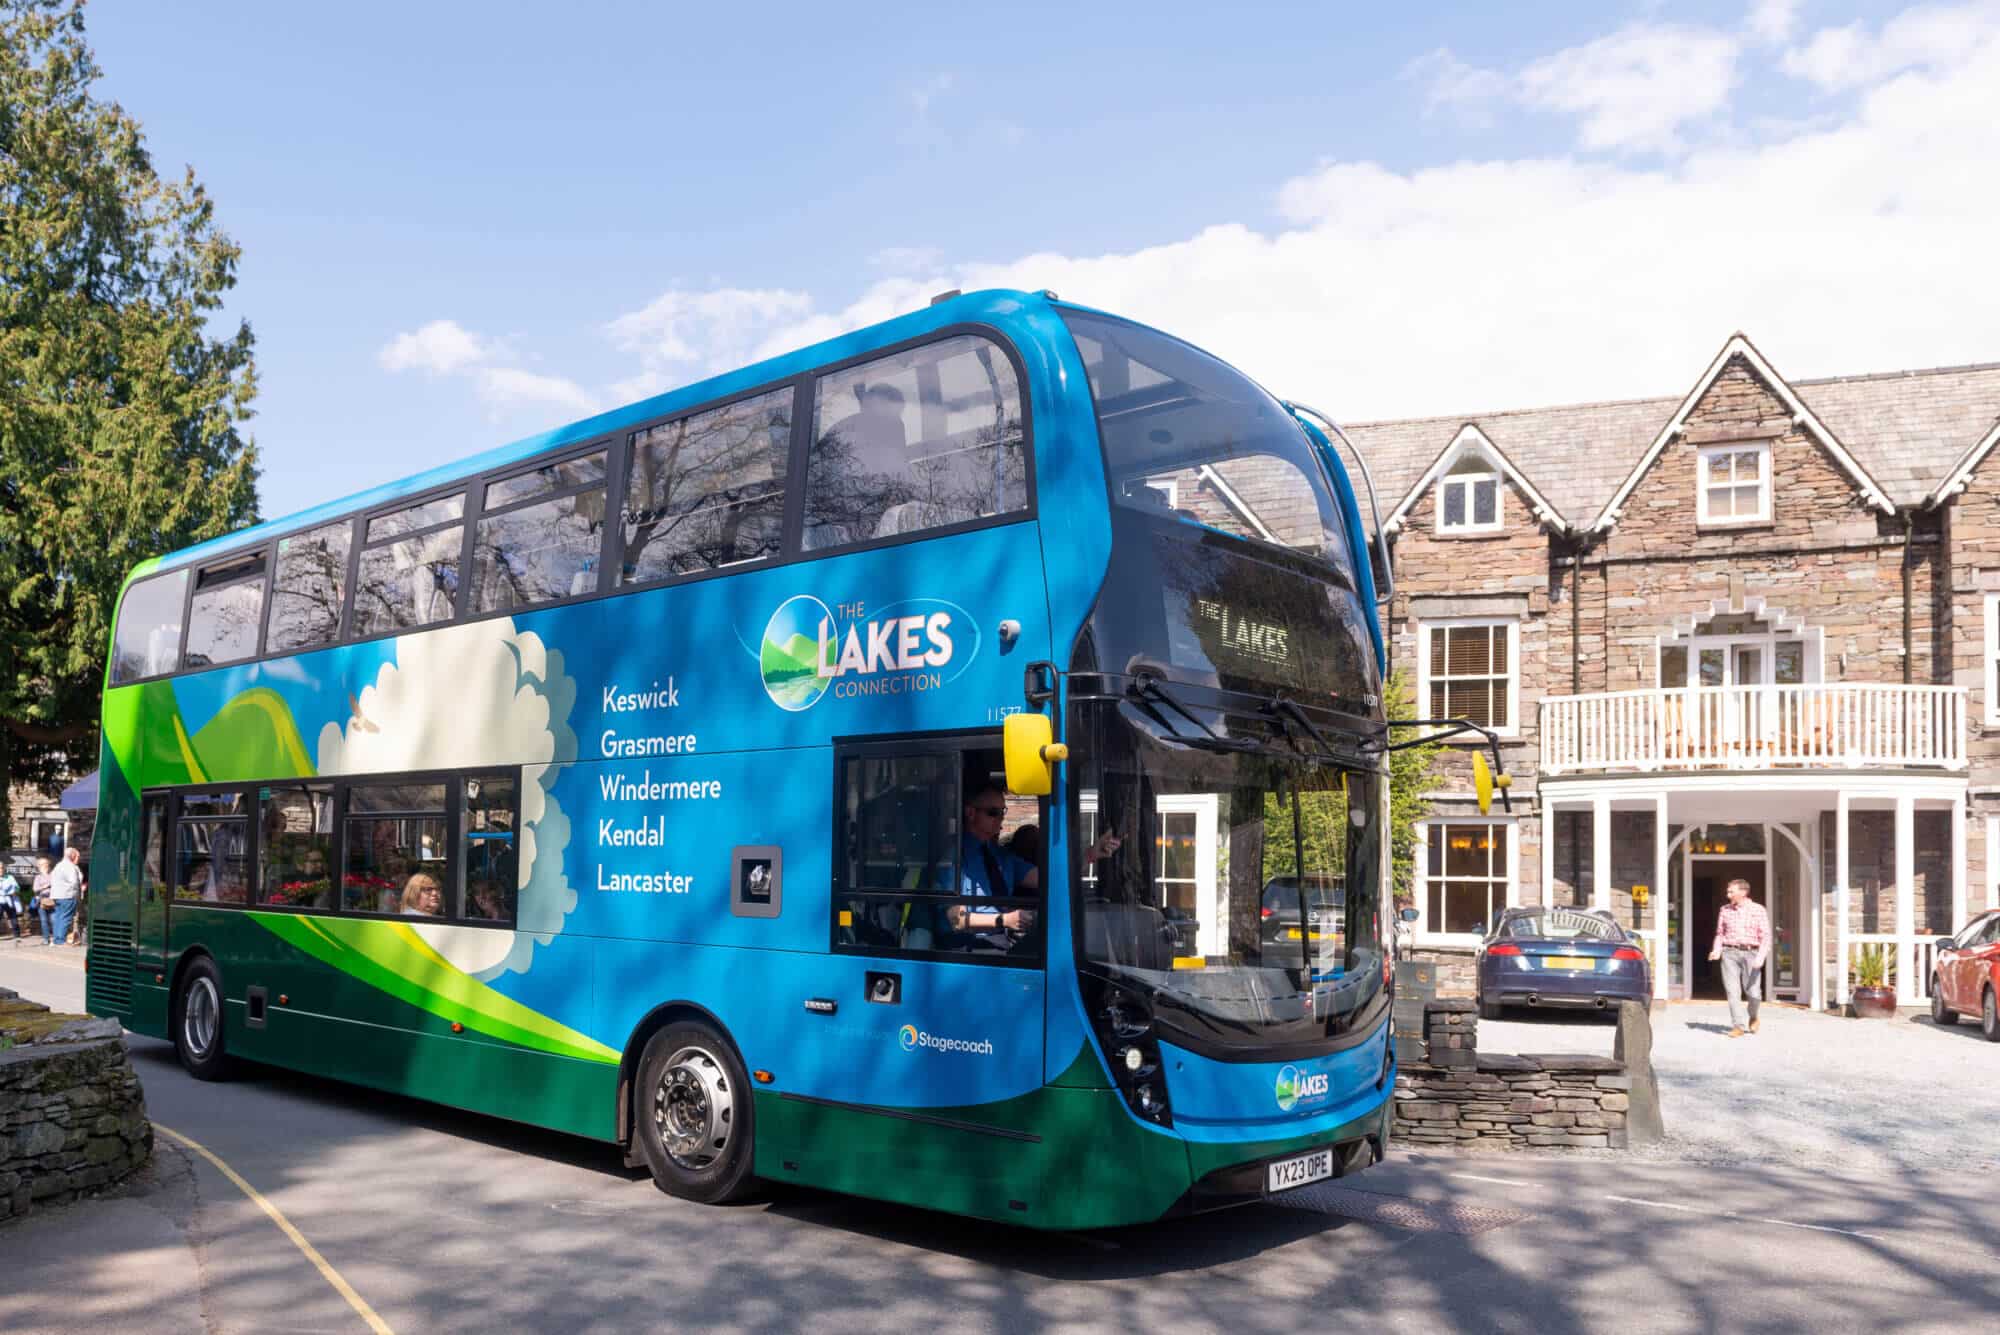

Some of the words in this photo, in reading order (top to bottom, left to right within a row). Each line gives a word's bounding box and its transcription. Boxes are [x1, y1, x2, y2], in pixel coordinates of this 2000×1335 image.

[836, 601, 865, 619] THE
[1199, 599, 1221, 620] THE
[816, 611, 953, 679] LAKES
[1221, 606, 1289, 660] LAKES
[602, 676, 679, 713] Keswick
[834, 672, 942, 699] CONNECTION
[601, 729, 697, 758] Grasmere
[599, 769, 722, 801] Windermere
[599, 815, 665, 847] Kendal
[597, 863, 693, 894] Lancaster
[918, 1031, 993, 1055] Stagecoach
[1293, 1073, 1329, 1098] LAKES
[1275, 1160, 1305, 1185] YX23
[1307, 1154, 1328, 1177] OPE
